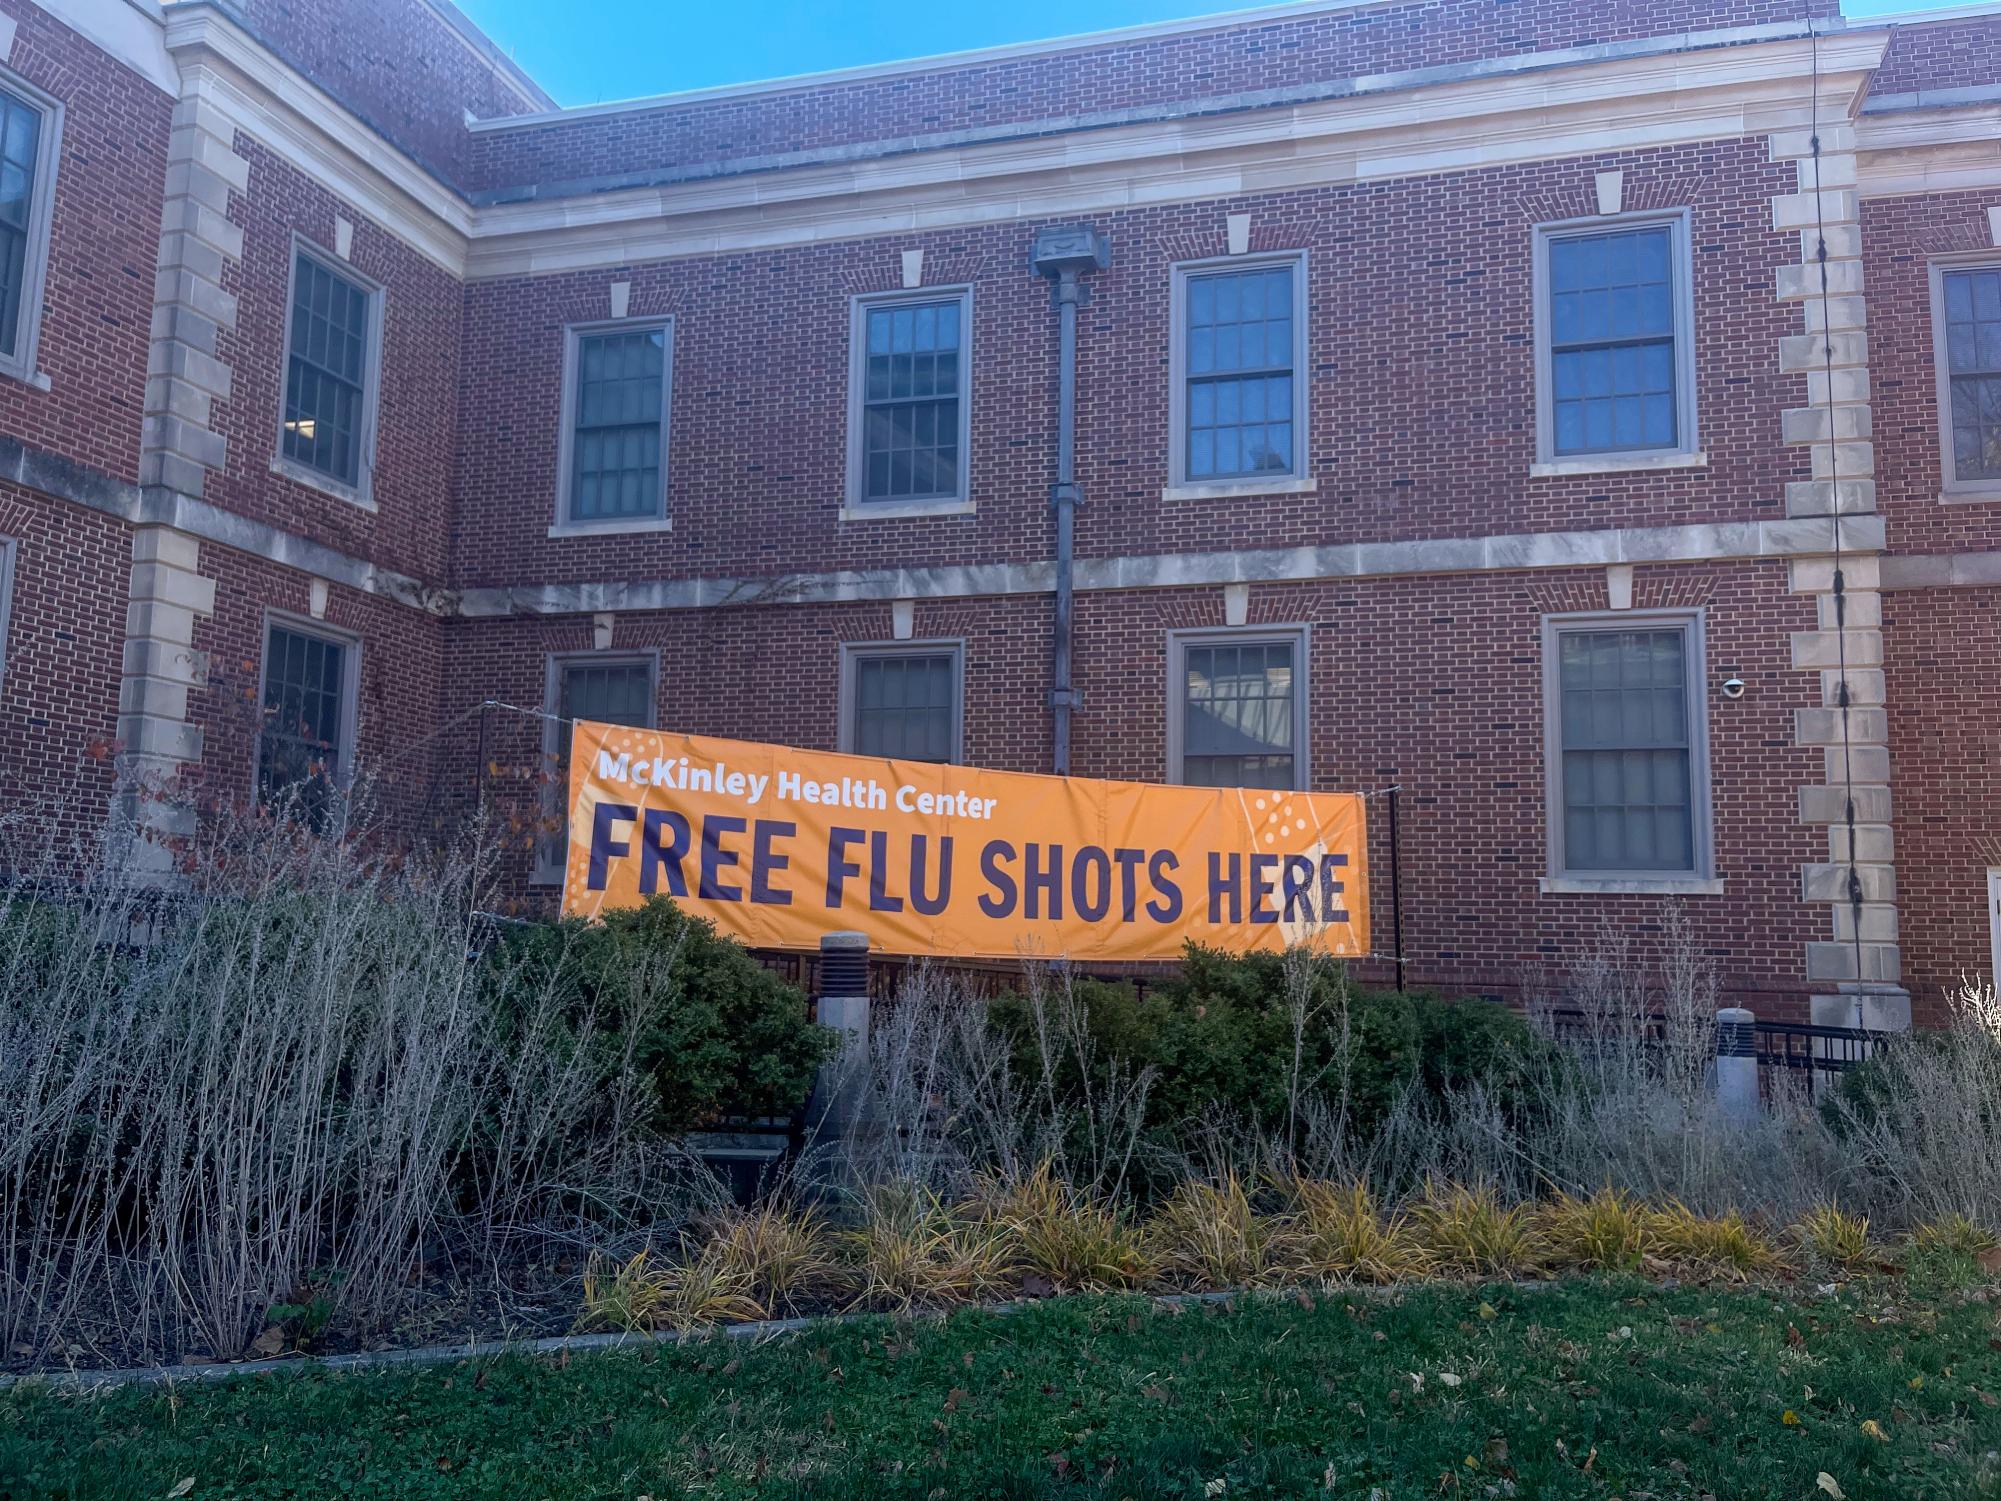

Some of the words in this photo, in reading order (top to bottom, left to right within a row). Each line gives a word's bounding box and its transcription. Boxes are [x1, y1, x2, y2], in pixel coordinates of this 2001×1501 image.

[599, 749, 768, 804] McKinley
[777, 771, 887, 810] Health
[896, 784, 997, 820] Center
[587, 801, 797, 906] FREE
[825, 826, 953, 916] FLU
[977, 839, 1183, 924] SHOTS
[1207, 851, 1350, 924] HERE
